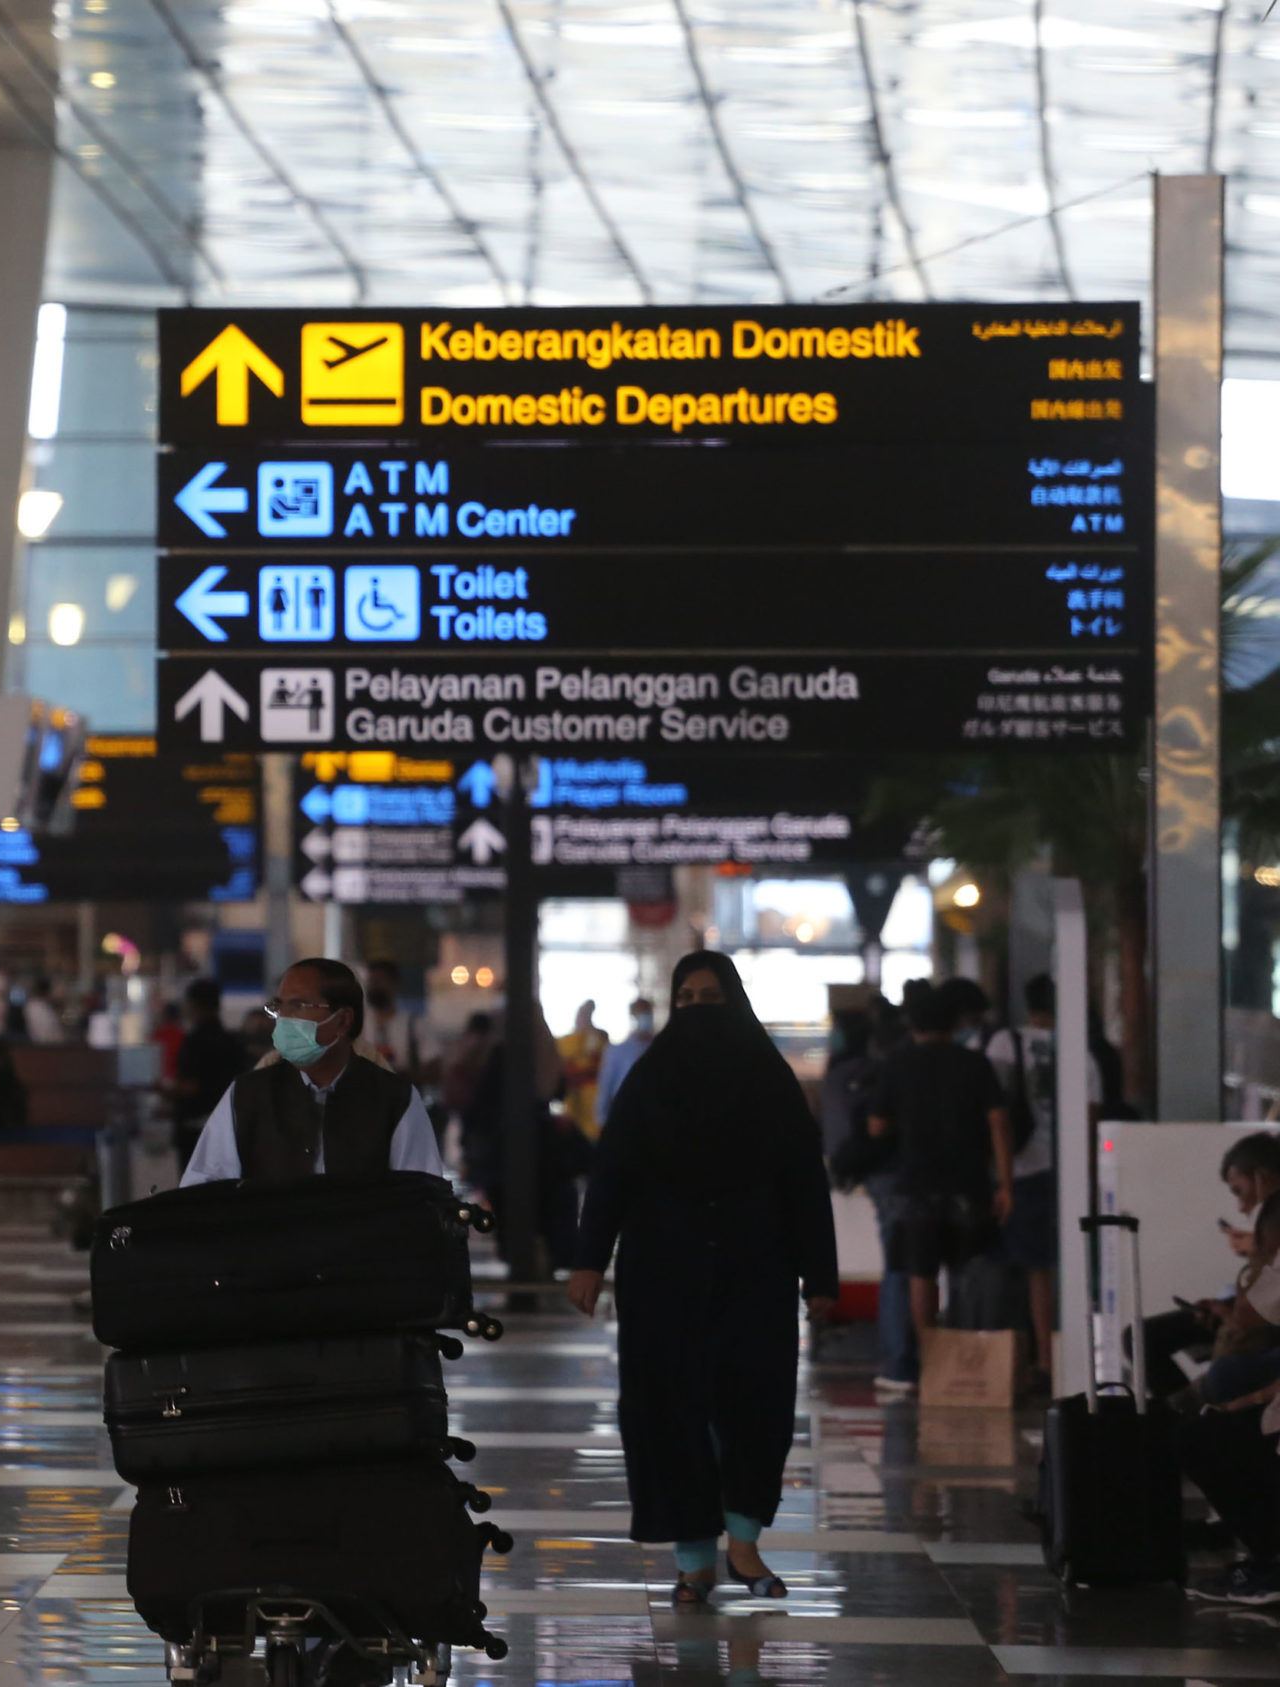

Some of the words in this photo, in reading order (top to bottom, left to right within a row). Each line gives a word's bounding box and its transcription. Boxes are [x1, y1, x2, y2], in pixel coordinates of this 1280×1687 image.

[419, 321, 722, 368] Keberangkatan
[731, 319, 921, 359] Domestik
[420, 385, 606, 426] Domestic
[615, 385, 839, 433] Departures
[456, 501, 577, 539] Center
[1070, 512, 1125, 534] ATM
[429, 563, 530, 601] Toilet
[429, 604, 549, 642] Toilets
[345, 668, 525, 708] Pelayanan
[536, 667, 717, 708] Pelanggan
[731, 667, 860, 702] Garuda
[346, 709, 473, 742] Garuda
[483, 709, 650, 742] Customer
[661, 709, 790, 741] Service
